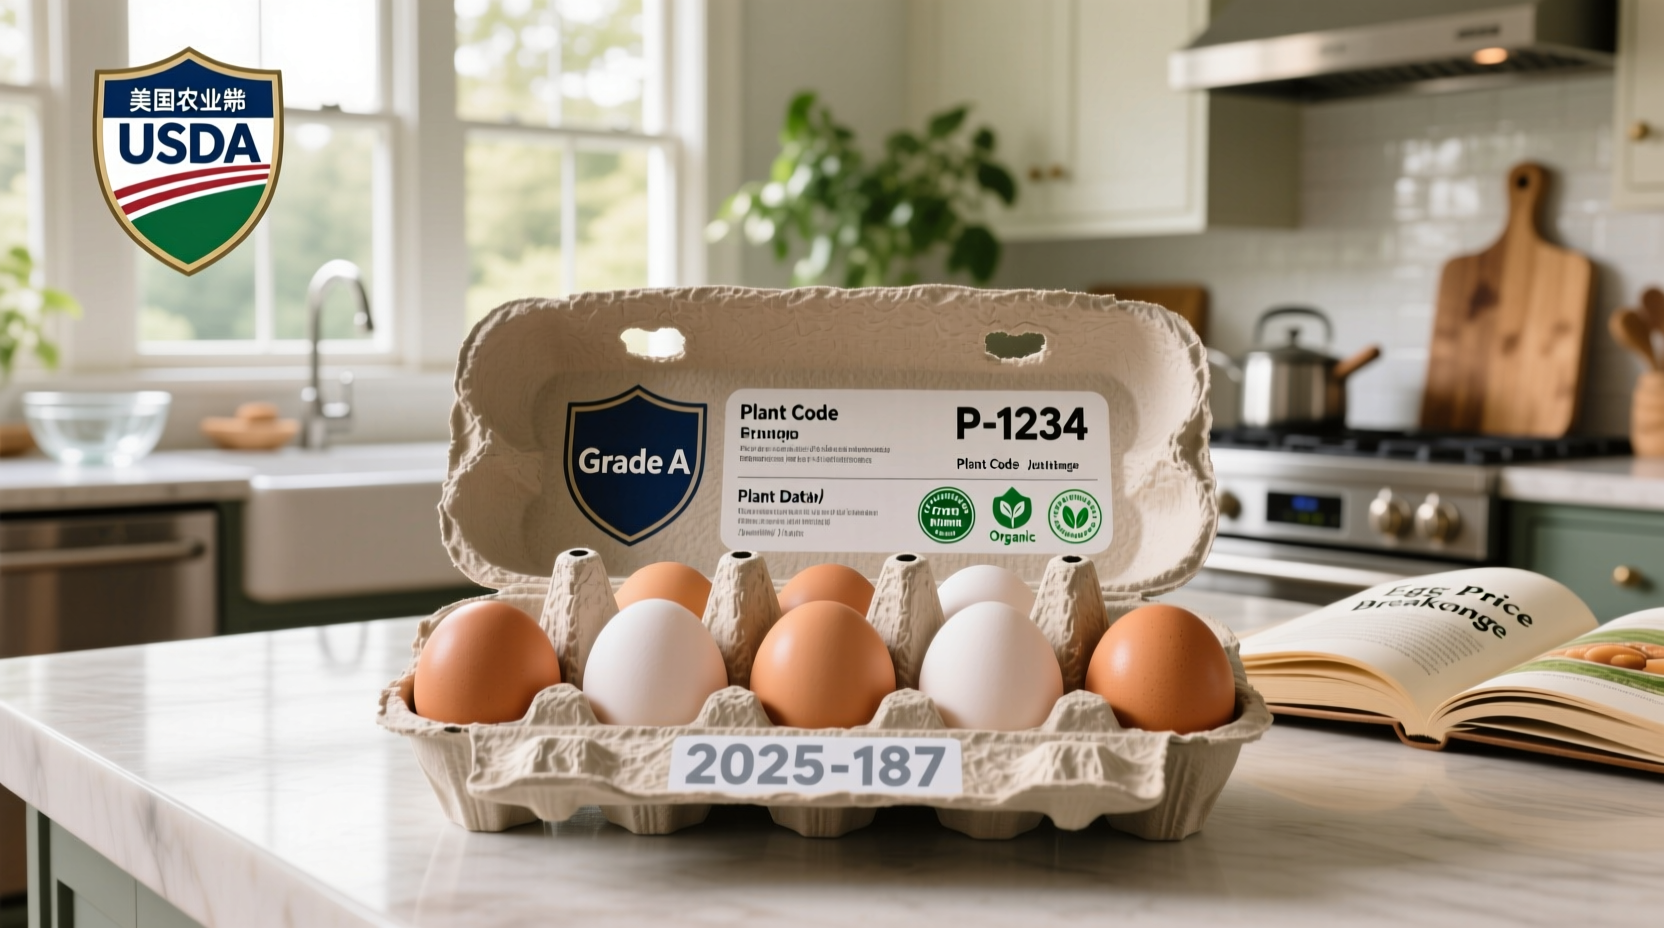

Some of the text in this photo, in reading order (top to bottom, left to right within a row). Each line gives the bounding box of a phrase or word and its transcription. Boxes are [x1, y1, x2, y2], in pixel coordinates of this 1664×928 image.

[740, 403, 839, 420] Plant Code
[956, 406, 1088, 441] P-1234
[578, 447, 691, 475] Grade A
[956, 457, 987, 470] Plant
[989, 457, 1020, 470] Code
[738, 489, 775, 503] Plant
[989, 530, 1036, 546] Organic
[1455, 585, 1533, 628] Price
[685, 742, 947, 787] 2025-187
